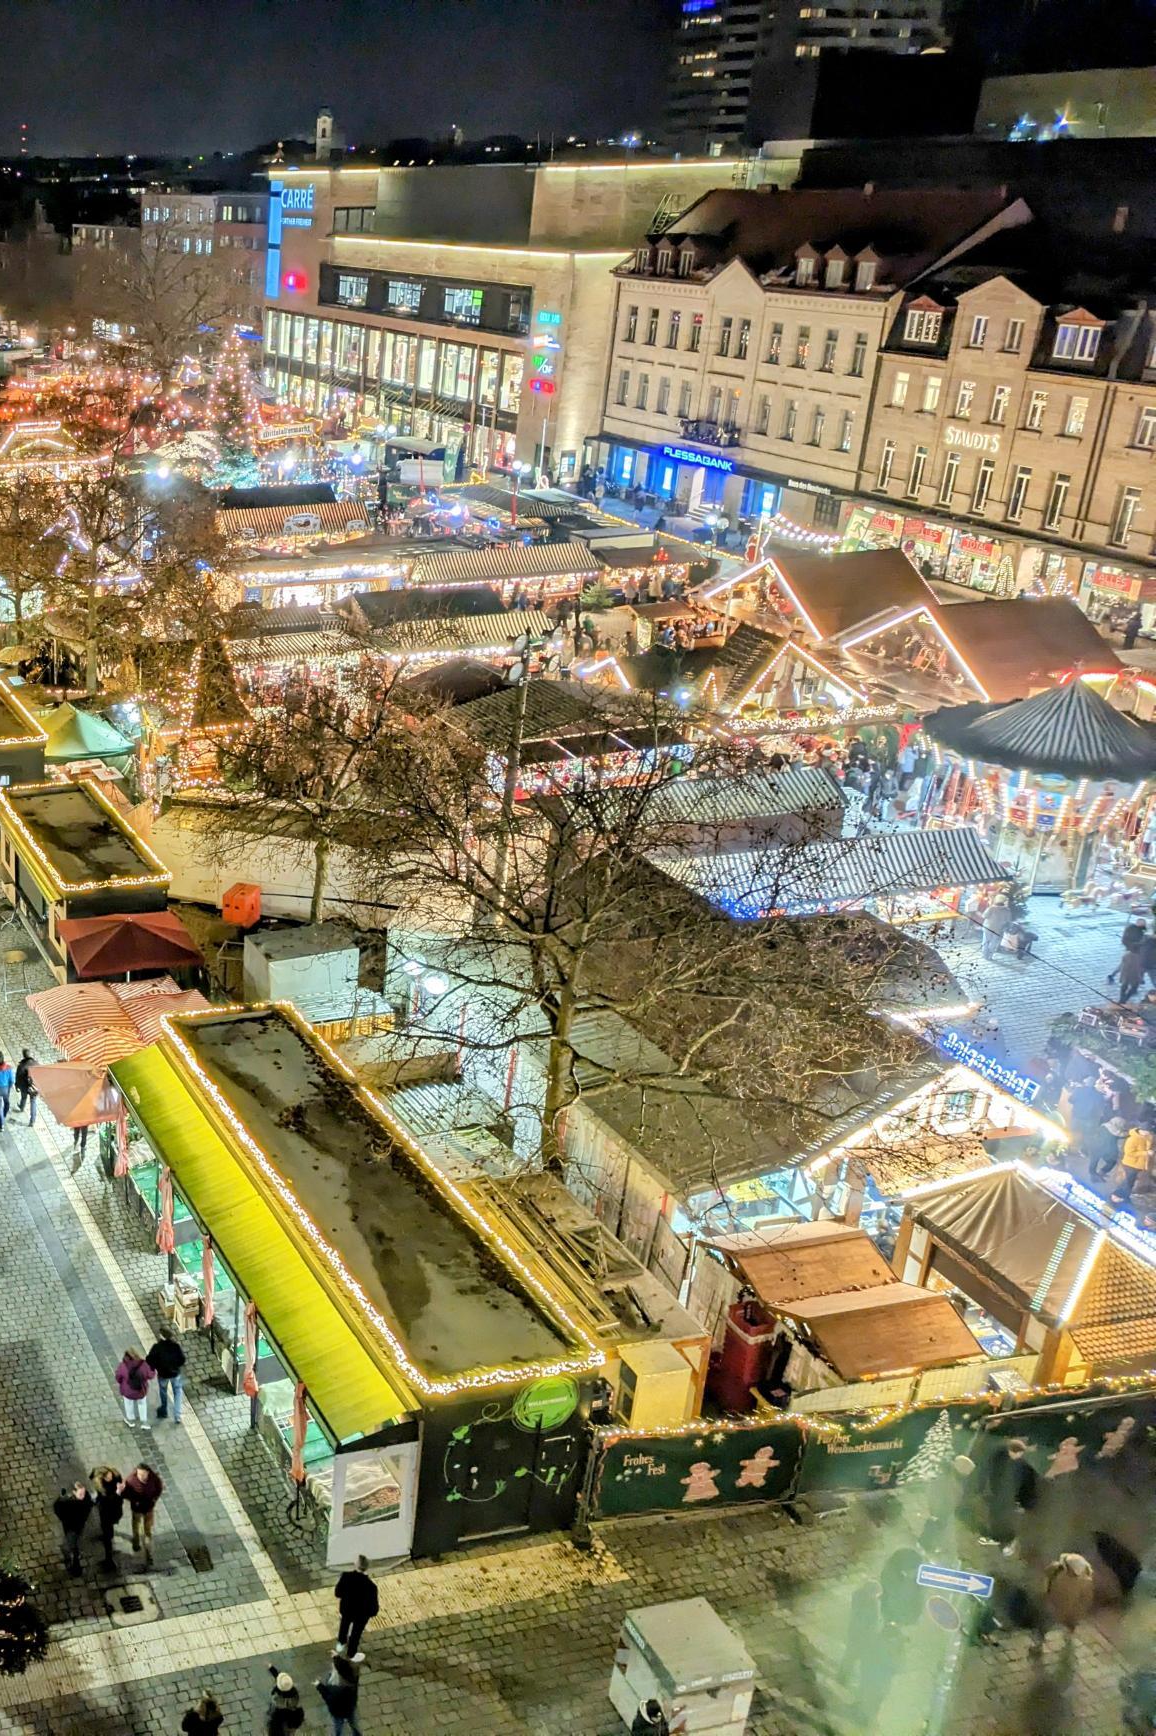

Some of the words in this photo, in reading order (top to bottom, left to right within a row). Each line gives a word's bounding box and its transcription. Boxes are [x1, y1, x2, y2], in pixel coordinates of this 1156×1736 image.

[281, 184, 314, 209] CARRÉ
[663, 446, 733, 472] FLESSABANK
[964, 539, 990, 554] TOTAL
[1097, 572, 1127, 588] ALLES
[827, 1437, 904, 1455] Weihnachtsmarkt
[623, 1453, 656, 1467] Frohes
[646, 1462, 667, 1476] Fest
